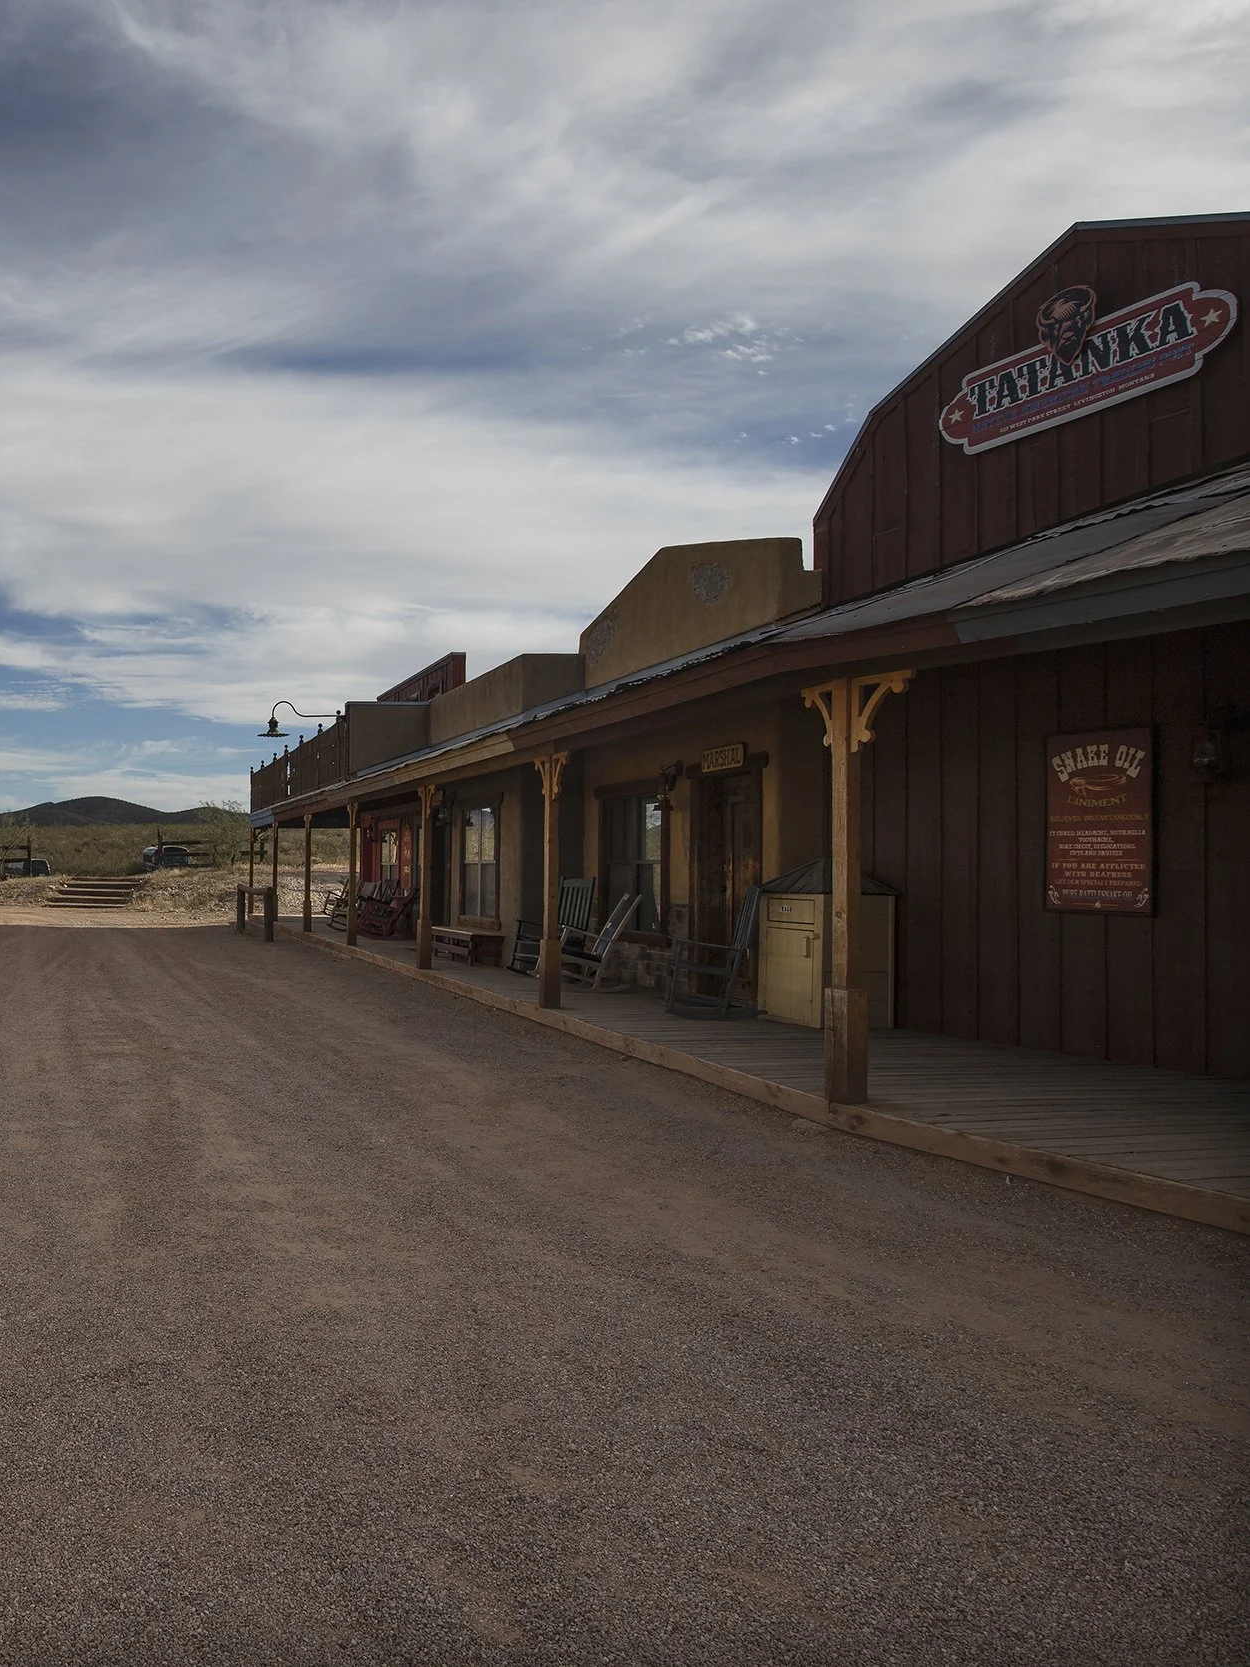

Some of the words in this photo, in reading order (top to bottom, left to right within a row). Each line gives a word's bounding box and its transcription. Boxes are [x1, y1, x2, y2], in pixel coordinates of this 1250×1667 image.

[966, 299, 1199, 420] TATANKA
[1009, 419, 1028, 429] WEST
[1027, 413, 1046, 423] PARK
[1045, 404, 1072, 417] STREET
[1073, 387, 1116, 406] LIVINGSTON
[702, 747, 740, 770] MARSHAL
[1051, 744, 1109, 783] SNAKE
[1114, 745, 1146, 778] OIL
[1068, 793, 1127, 808] LINIMENT
[1099, 862, 1146, 870] AFFLICTED
[1079, 889, 1121, 899] RATTLESNAKE
